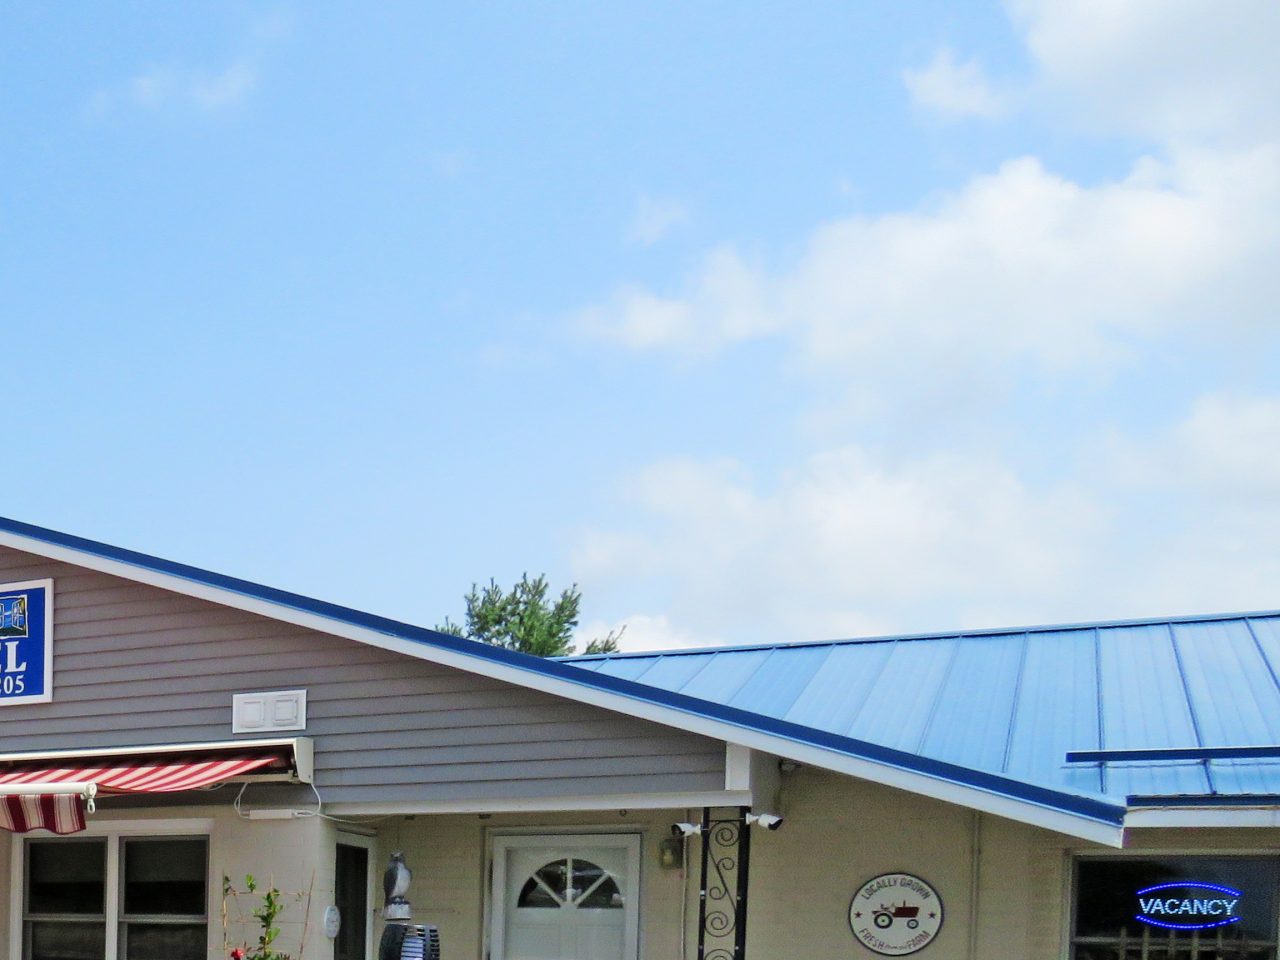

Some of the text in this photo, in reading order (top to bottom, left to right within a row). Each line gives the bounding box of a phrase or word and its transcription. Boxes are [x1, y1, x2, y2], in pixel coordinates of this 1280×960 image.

[861, 877, 931, 900] LOCALLY GROWN
[1138, 898, 1239, 916] VACANCY
[859, 928, 886, 950] FRESH
